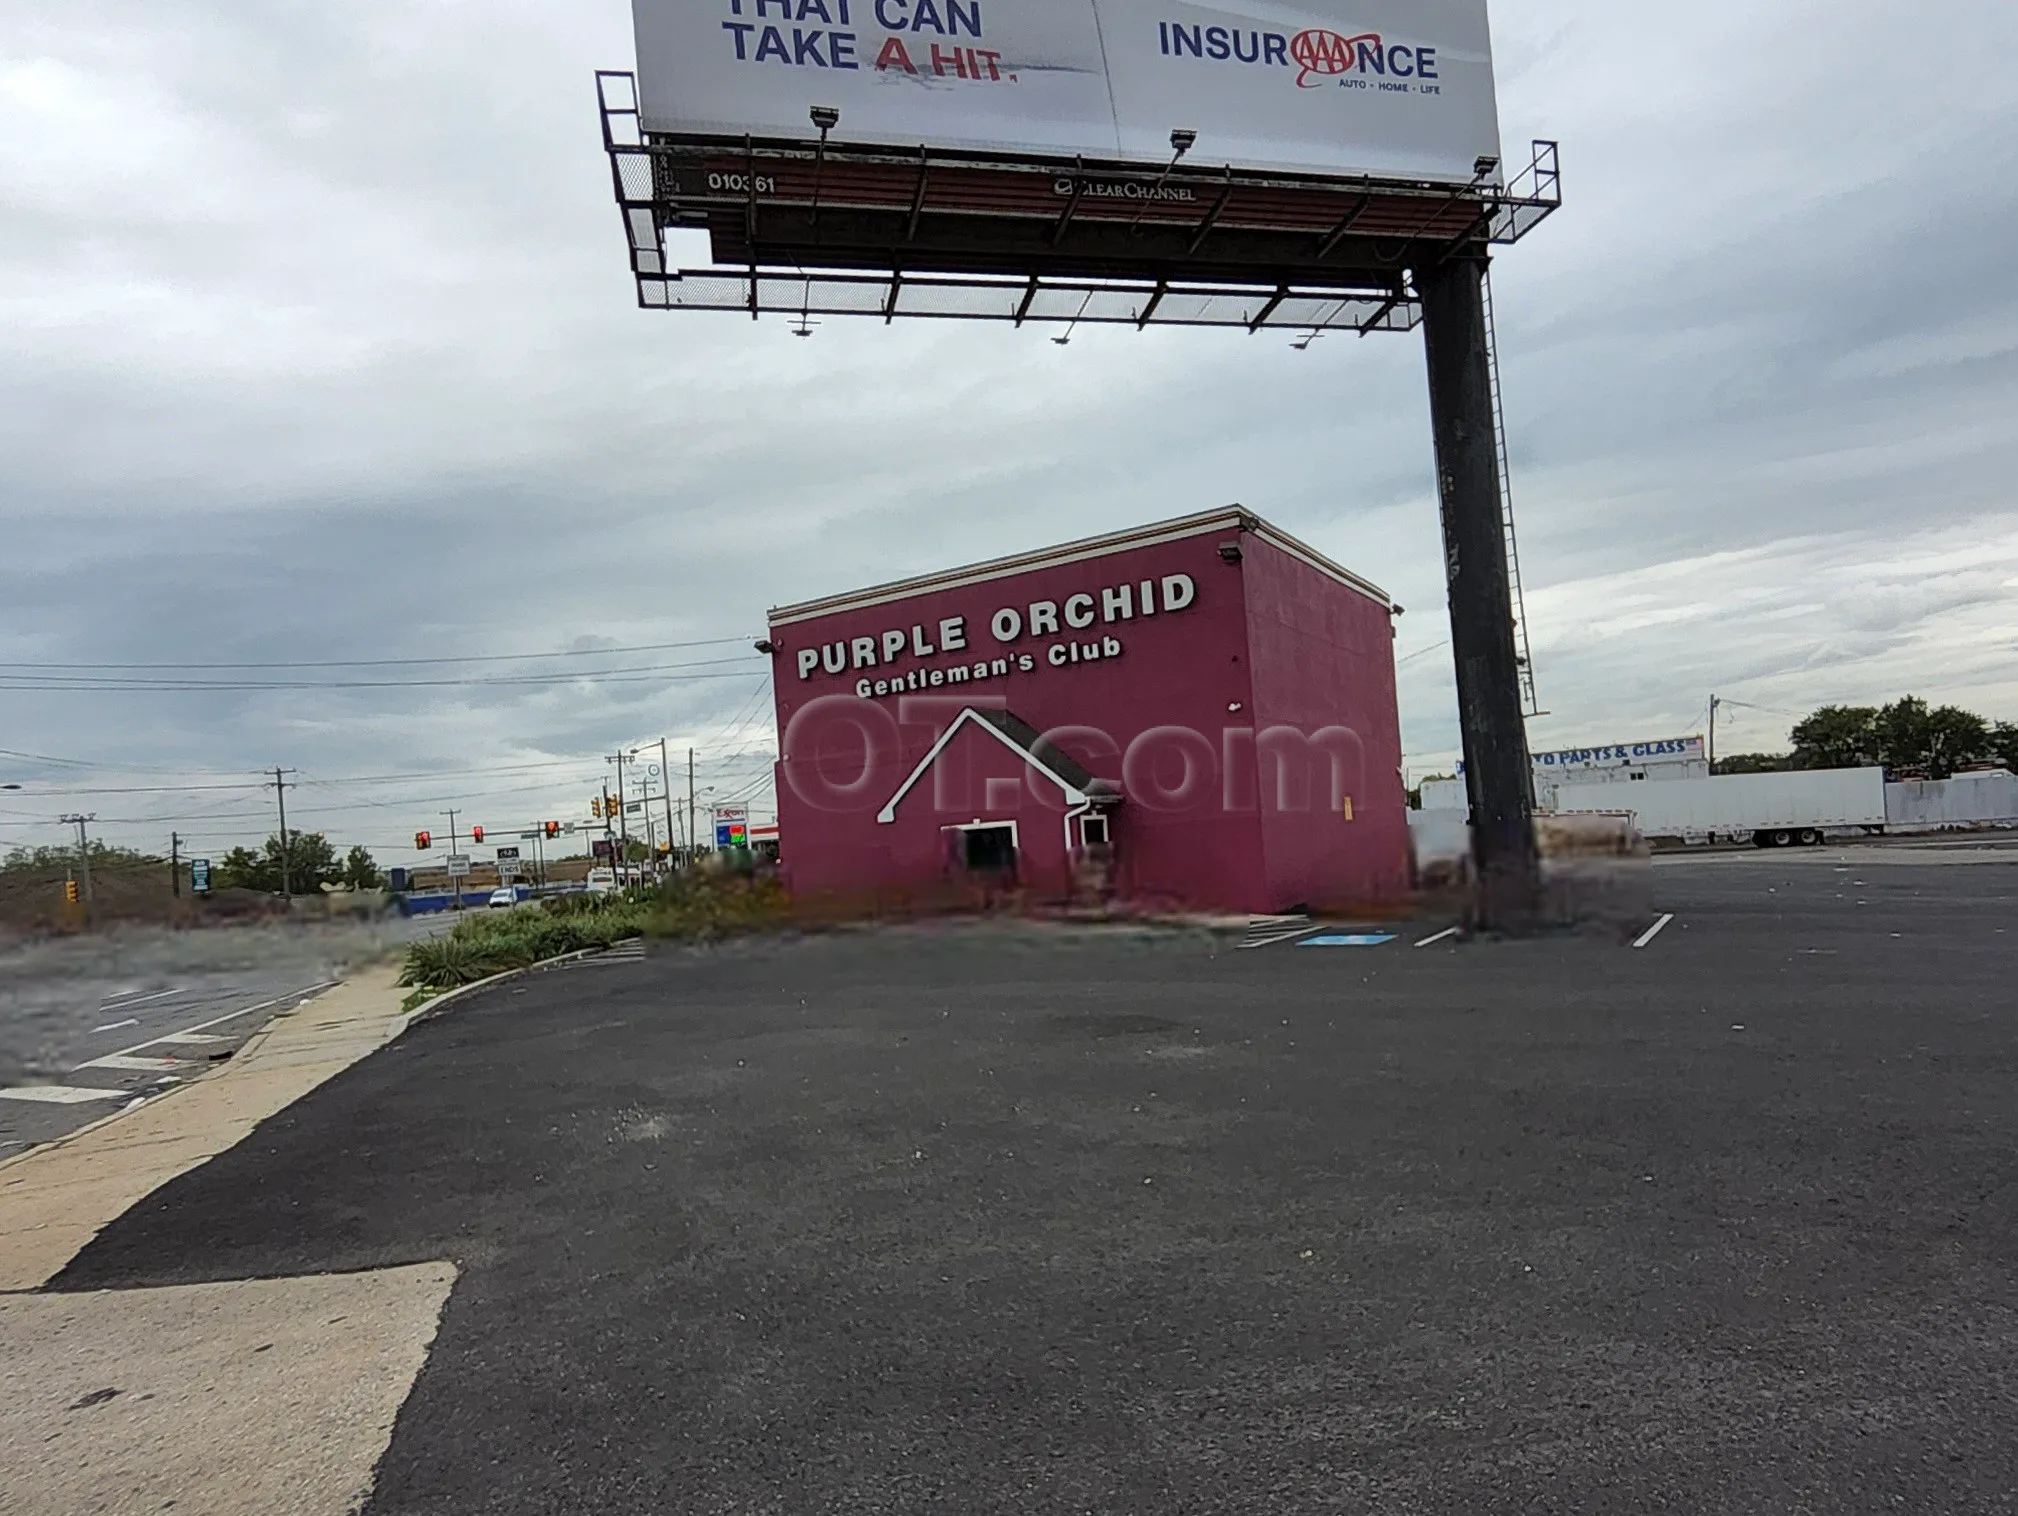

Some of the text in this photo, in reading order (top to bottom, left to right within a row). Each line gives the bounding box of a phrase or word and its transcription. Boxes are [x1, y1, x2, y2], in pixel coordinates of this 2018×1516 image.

[874, 0, 982, 38] CAN
[721, 21, 1018, 83] TAKE A HIT.
[1338, 78, 1441, 95] AUTO HOME LIFE
[1082, 181, 1197, 201] LEARCHANNEL
[796, 573, 1197, 680] PURPLE ORCHID
[855, 636, 1122, 699] Gentleman's Club
[1559, 749, 1612, 766] PARTS
[1614, 745, 1629, 759] &
[1632, 739, 1686, 757] GLASS
